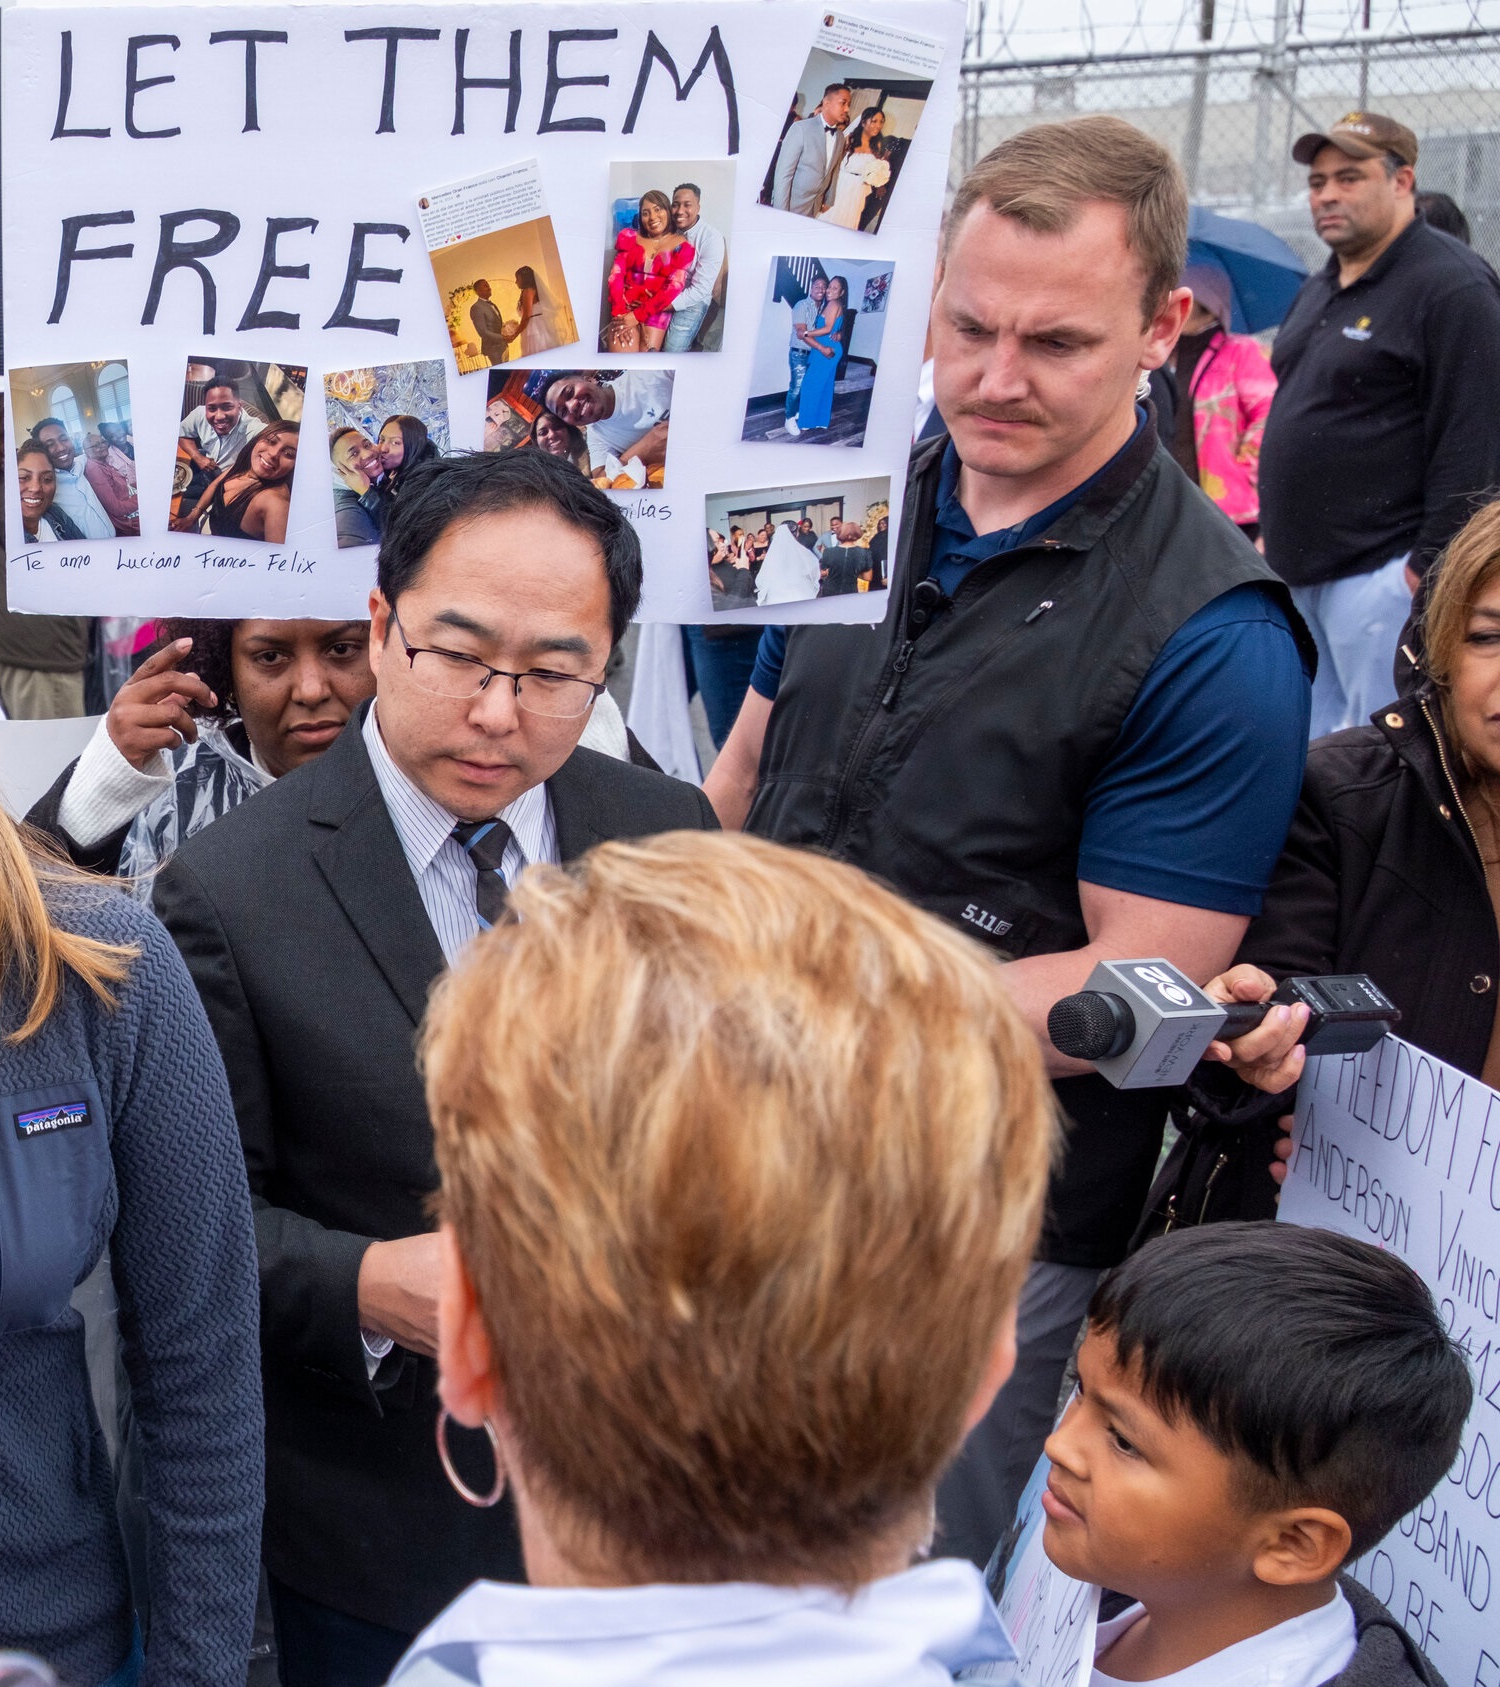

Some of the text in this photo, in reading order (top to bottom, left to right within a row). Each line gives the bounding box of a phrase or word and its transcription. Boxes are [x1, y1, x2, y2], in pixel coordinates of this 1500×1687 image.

[50, 25, 740, 155] LET THEM
[46, 208, 410, 336] FREE
[10, 550, 45, 572] Te
[59, 553, 91, 568] amo
[116, 549, 181, 570] Luciano
[267, 553, 317, 575] Felix
[961, 903, 997, 932] 5.11
[25, 1114, 83, 1135] patagonia
[1293, 1102, 1500, 1325] ANDERSON VINIC
